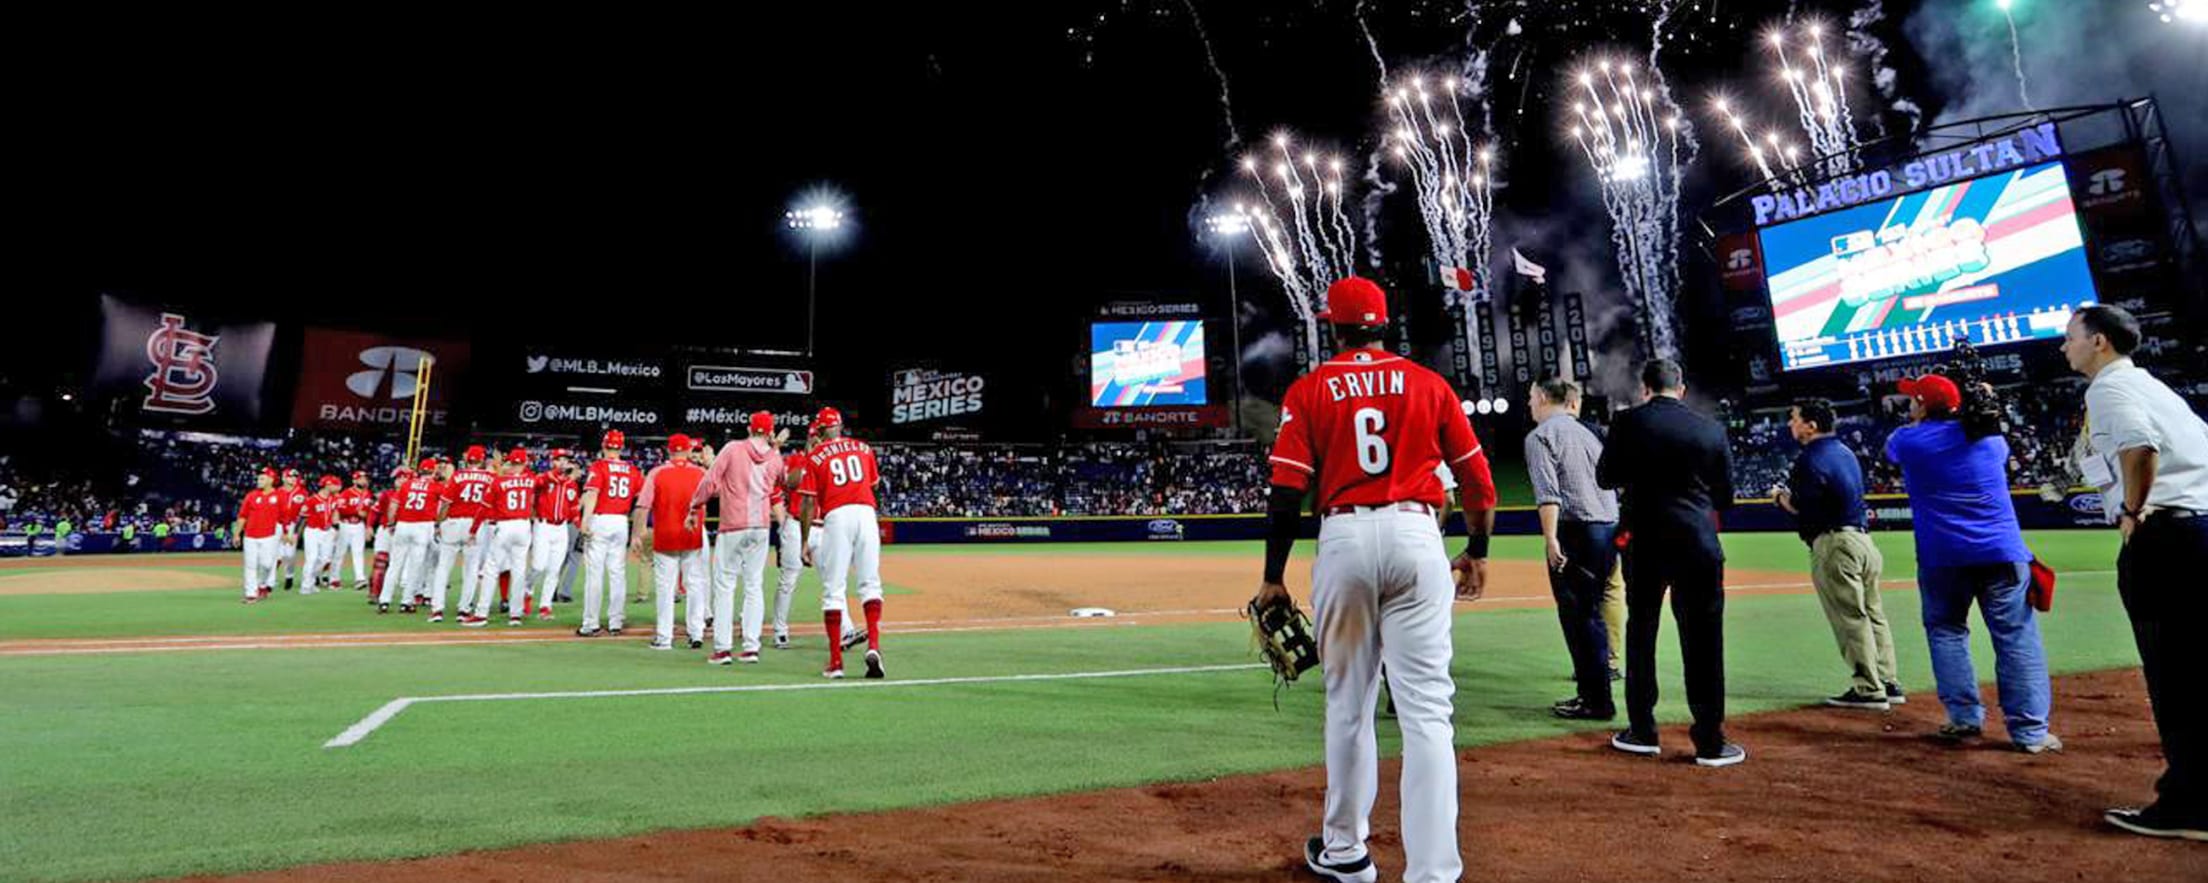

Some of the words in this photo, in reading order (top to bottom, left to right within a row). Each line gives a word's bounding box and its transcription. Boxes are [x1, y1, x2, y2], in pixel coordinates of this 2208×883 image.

[1751, 170, 1893, 225] PALACIO
[1905, 122, 2062, 187] SULTAN
[1481, 317, 1498, 385] 1995
[1569, 310, 1590, 377] 2018
[549, 358, 661, 377] @MLB_Mexico
[694, 371, 781, 388] @LosMayores
[892, 375, 984, 404] MEXICO
[1327, 370, 1405, 402] ERVIN
[544, 404, 658, 424] @MLBMexico
[685, 407, 810, 426] #Méxiceries
[891, 393, 984, 424] SERIES
[1125, 411, 1198, 423] BANORTE
[1354, 407, 1389, 474] 6
[830, 455, 863, 486] 90
[460, 483, 484, 503] 45
[608, 475, 630, 498] 56
[404, 492, 428, 511] 25
[507, 490, 527, 510] 61
[978, 527, 1015, 537] MEXICO
